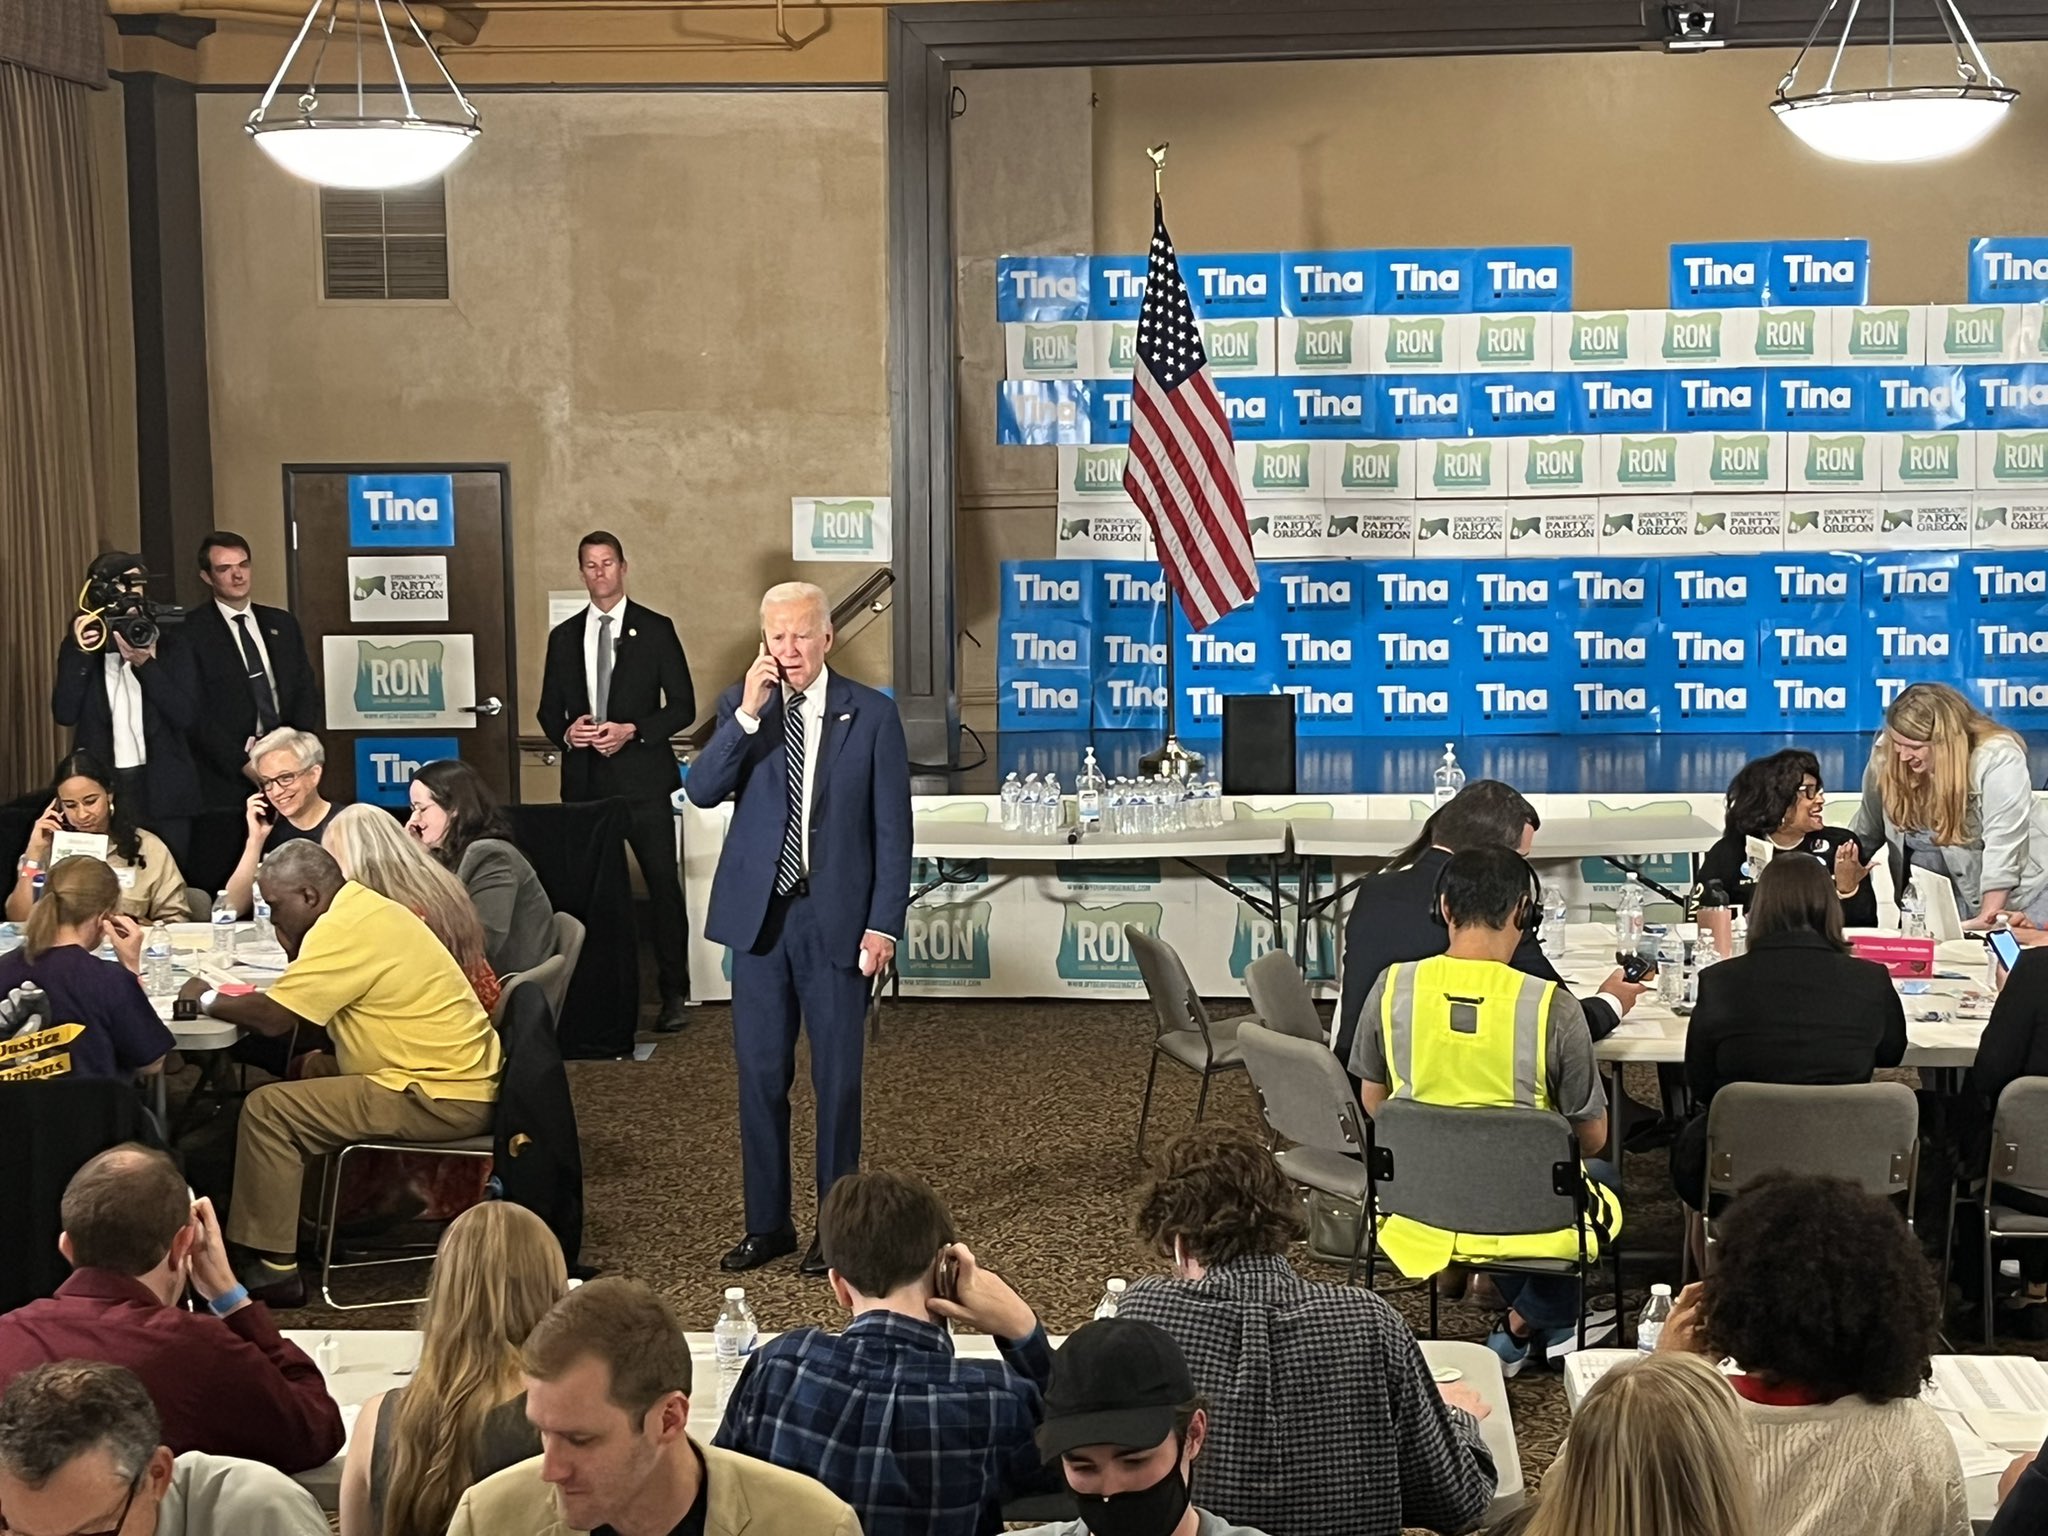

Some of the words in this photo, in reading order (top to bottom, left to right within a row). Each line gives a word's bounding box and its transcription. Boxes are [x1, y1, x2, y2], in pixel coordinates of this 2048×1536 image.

[1294, 266, 1363, 293] Tina
[1390, 264, 1459, 291] Tina
[1487, 262, 1557, 290] Tina
[1684, 258, 1754, 286] Tina
[1783, 255, 1854, 283] Tina
[1983, 252, 2048, 280] Tina
[1010, 271, 1077, 299] Tina
[1104, 270, 1148, 298] Tin
[1198, 268, 1266, 296] Tina
[1211, 332, 1249, 357] RON
[1306, 330, 1343, 354] RON
[1396, 330, 1434, 352] RON
[1488, 328, 1525, 351] RON
[1580, 326, 1618, 350] RON
[1673, 324, 1711, 348] RON
[1766, 322, 1804, 345] RON
[1860, 320, 1898, 344] RON
[1956, 320, 1994, 344] RON
[1032, 336, 1068, 360] RON
[1293, 389, 1361, 417] Tina
[1389, 388, 1457, 415] Tina
[1486, 385, 1555, 413] Tina
[1583, 382, 1652, 409] Tina
[1681, 380, 1751, 408] Tina
[1781, 381, 1851, 408] Tina
[1880, 380, 1950, 408] Tina
[1980, 379, 2048, 407] Tina
[1103, 394, 1130, 420] Ti
[1263, 455, 1301, 478] RON
[1353, 454, 1390, 478] RON
[1444, 453, 1482, 476] RON
[1536, 450, 1574, 474] RON
[1628, 448, 1666, 472] RON
[1722, 447, 1759, 470] RON
[1816, 447, 1854, 470] RON
[1910, 445, 1948, 469] RON
[2005, 444, 2044, 468] RON
[1084, 459, 1122, 482] RON
[363, 491, 437, 521] Tina
[1824, 515, 1866, 524] PARTY
[1918, 514, 1959, 522] PARTY
[2012, 512, 2046, 521] PART
[823, 511, 864, 538] RON
[1273, 529, 1321, 538] OREGON
[1274, 521, 1314, 529] PARTY
[1361, 530, 1410, 539] OREGON
[1452, 531, 1502, 540] OREGON
[1454, 523, 1494, 532] PARTY
[1545, 521, 1586, 530] PARTY
[1545, 529, 1595, 538] OREGON
[1637, 526, 1688, 535] OREGON
[1638, 518, 1680, 526] PARTY
[1730, 518, 1772, 526] PARTY
[1730, 525, 1780, 535] OREGON
[1823, 523, 1874, 533] OREGON
[1917, 522, 1968, 532] OREGON
[2011, 521, 2048, 530] OREGO
[1093, 533, 1141, 542] OREGON
[391, 581, 435, 590] PARTY
[1013, 574, 1079, 601] Tina
[1280, 576, 1350, 604] Tina
[1378, 574, 1448, 601] Tina
[1477, 574, 1548, 602] Tina
[1573, 571, 1644, 600] Tina
[1675, 571, 1746, 599] Tina
[1775, 566, 1847, 595] Tina
[1877, 565, 1949, 594] Tina
[1973, 566, 2045, 594] Tina
[390, 590, 443, 600] OREGON
[1012, 633, 1076, 660] Tina
[1104, 636, 1167, 664] Tina
[1187, 634, 1255, 663] Tina
[1281, 634, 1351, 661] Tina
[1378, 633, 1449, 661] Tina
[1477, 625, 1548, 653] Tina
[1574, 631, 1645, 659] Tina
[1673, 632, 1744, 660] Tina
[1775, 629, 1846, 656] Tina
[1877, 627, 1948, 655] Tina
[1978, 625, 2048, 654] Tina
[371, 658, 430, 696] RON
[1012, 682, 1078, 708] Tina
[1186, 688, 1223, 716] Ti
[1283, 686, 1353, 714] Tina
[1378, 686, 1448, 713] Tina
[1476, 684, 1547, 711] Tina
[1574, 683, 1645, 711] Tina
[1675, 683, 1746, 709] Tina
[1774, 680, 1845, 708] Tina
[1977, 679, 2048, 707] Tina
[370, 754, 428, 784] Tin
[908, 919, 973, 961] RON
